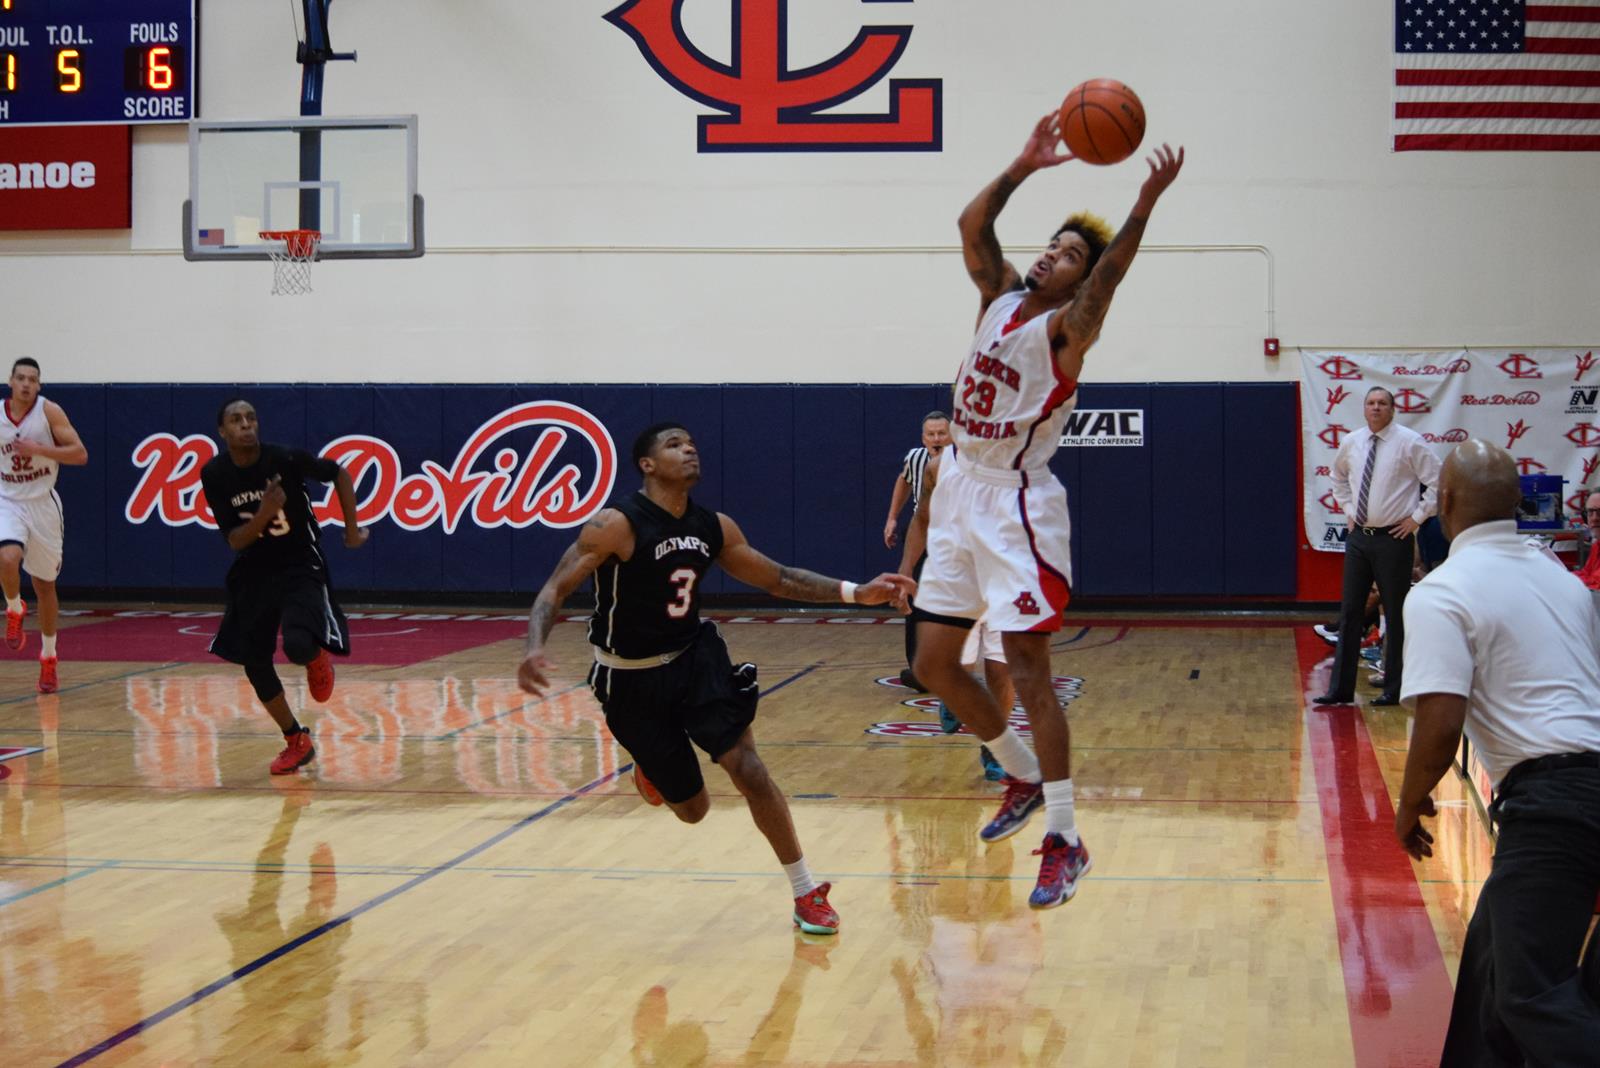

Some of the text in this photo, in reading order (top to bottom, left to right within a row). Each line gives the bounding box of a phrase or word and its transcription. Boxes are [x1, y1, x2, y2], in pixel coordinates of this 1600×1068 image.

[46, 25, 93, 45] T.O.L.
[130, 22, 179, 43] FOULS
[57, 49, 81, 92] 5
[149, 47, 172, 89] 6
[124, 96, 184, 118] SCORE
[0, 161, 96, 189] anoe
[1391, 366, 1420, 376] Red
[962, 375, 997, 417] 23
[1460, 395, 1488, 406] Red
[231, 490, 265, 507] OLYM
[667, 568, 697, 617] 3
